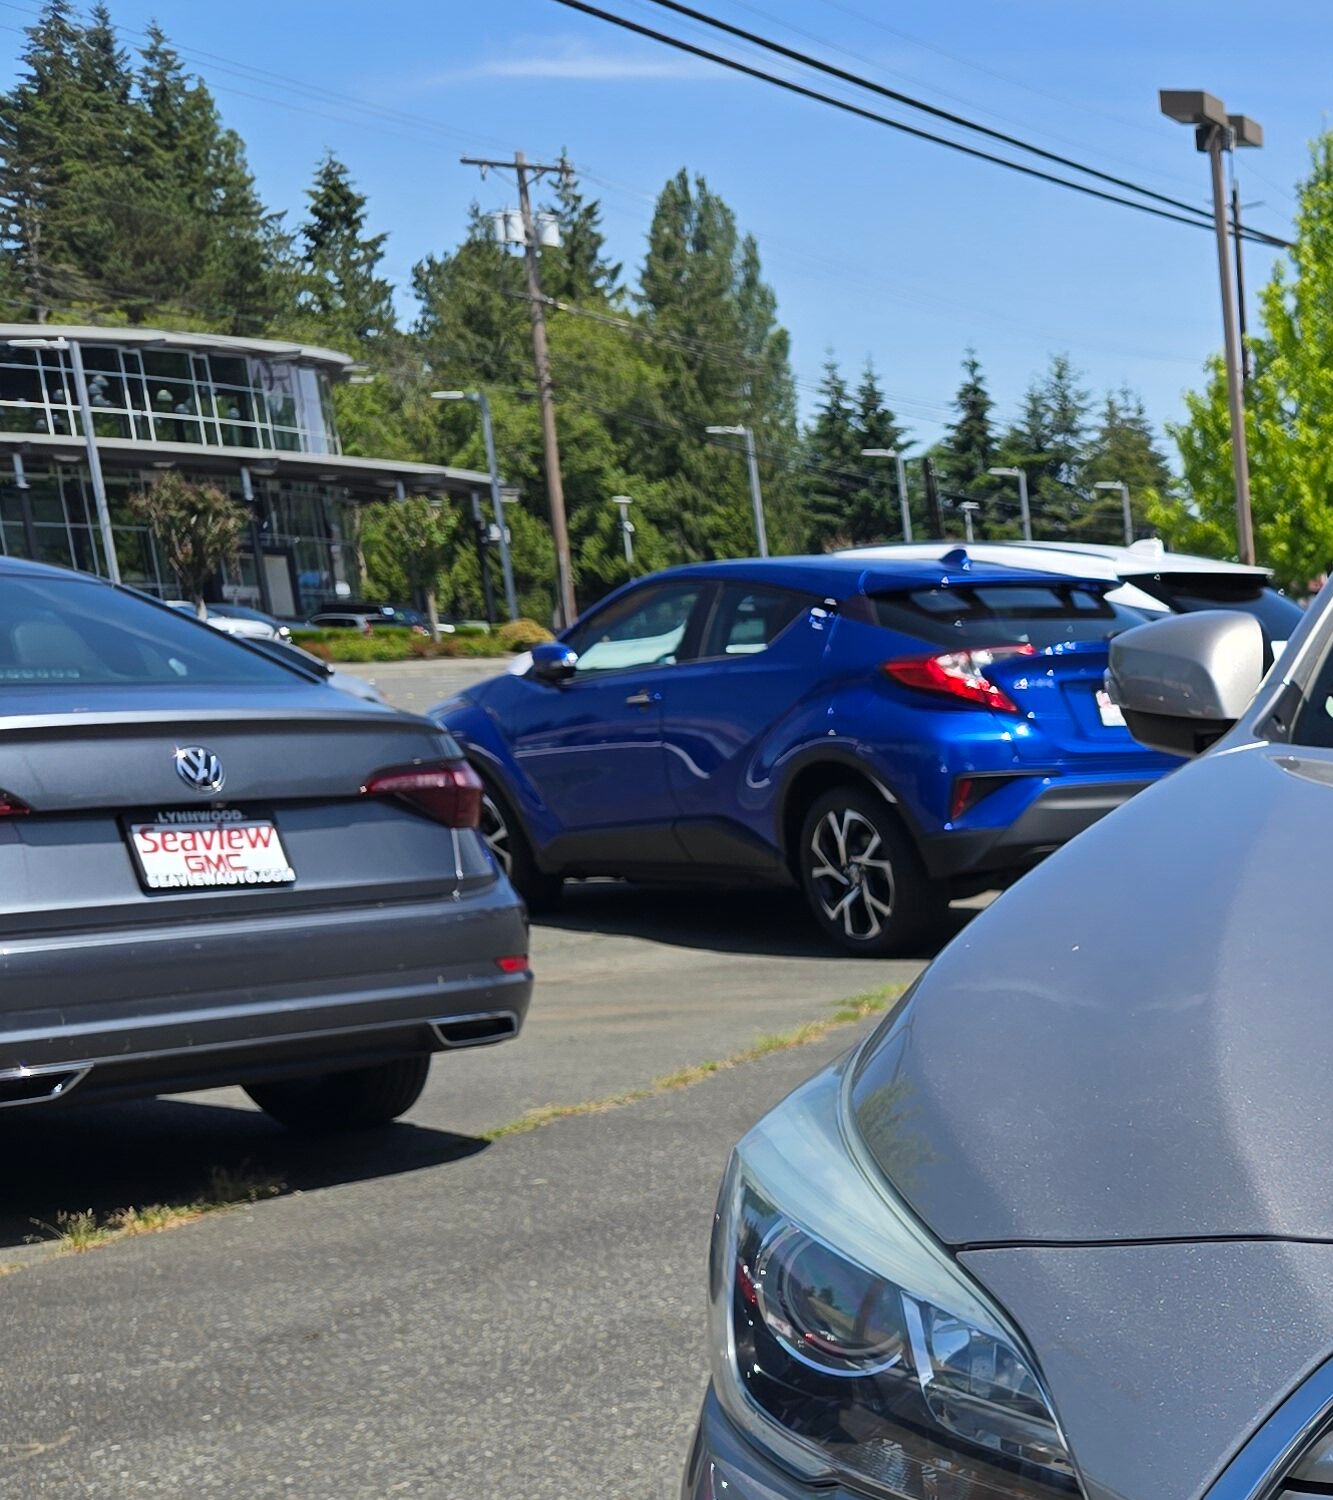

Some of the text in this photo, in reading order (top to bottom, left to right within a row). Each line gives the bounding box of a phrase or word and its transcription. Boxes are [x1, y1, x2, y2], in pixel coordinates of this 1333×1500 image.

[157, 809, 243, 824] LYNNWOOD
[140, 820, 274, 854] Seaview
[184, 853, 248, 873] GMC
